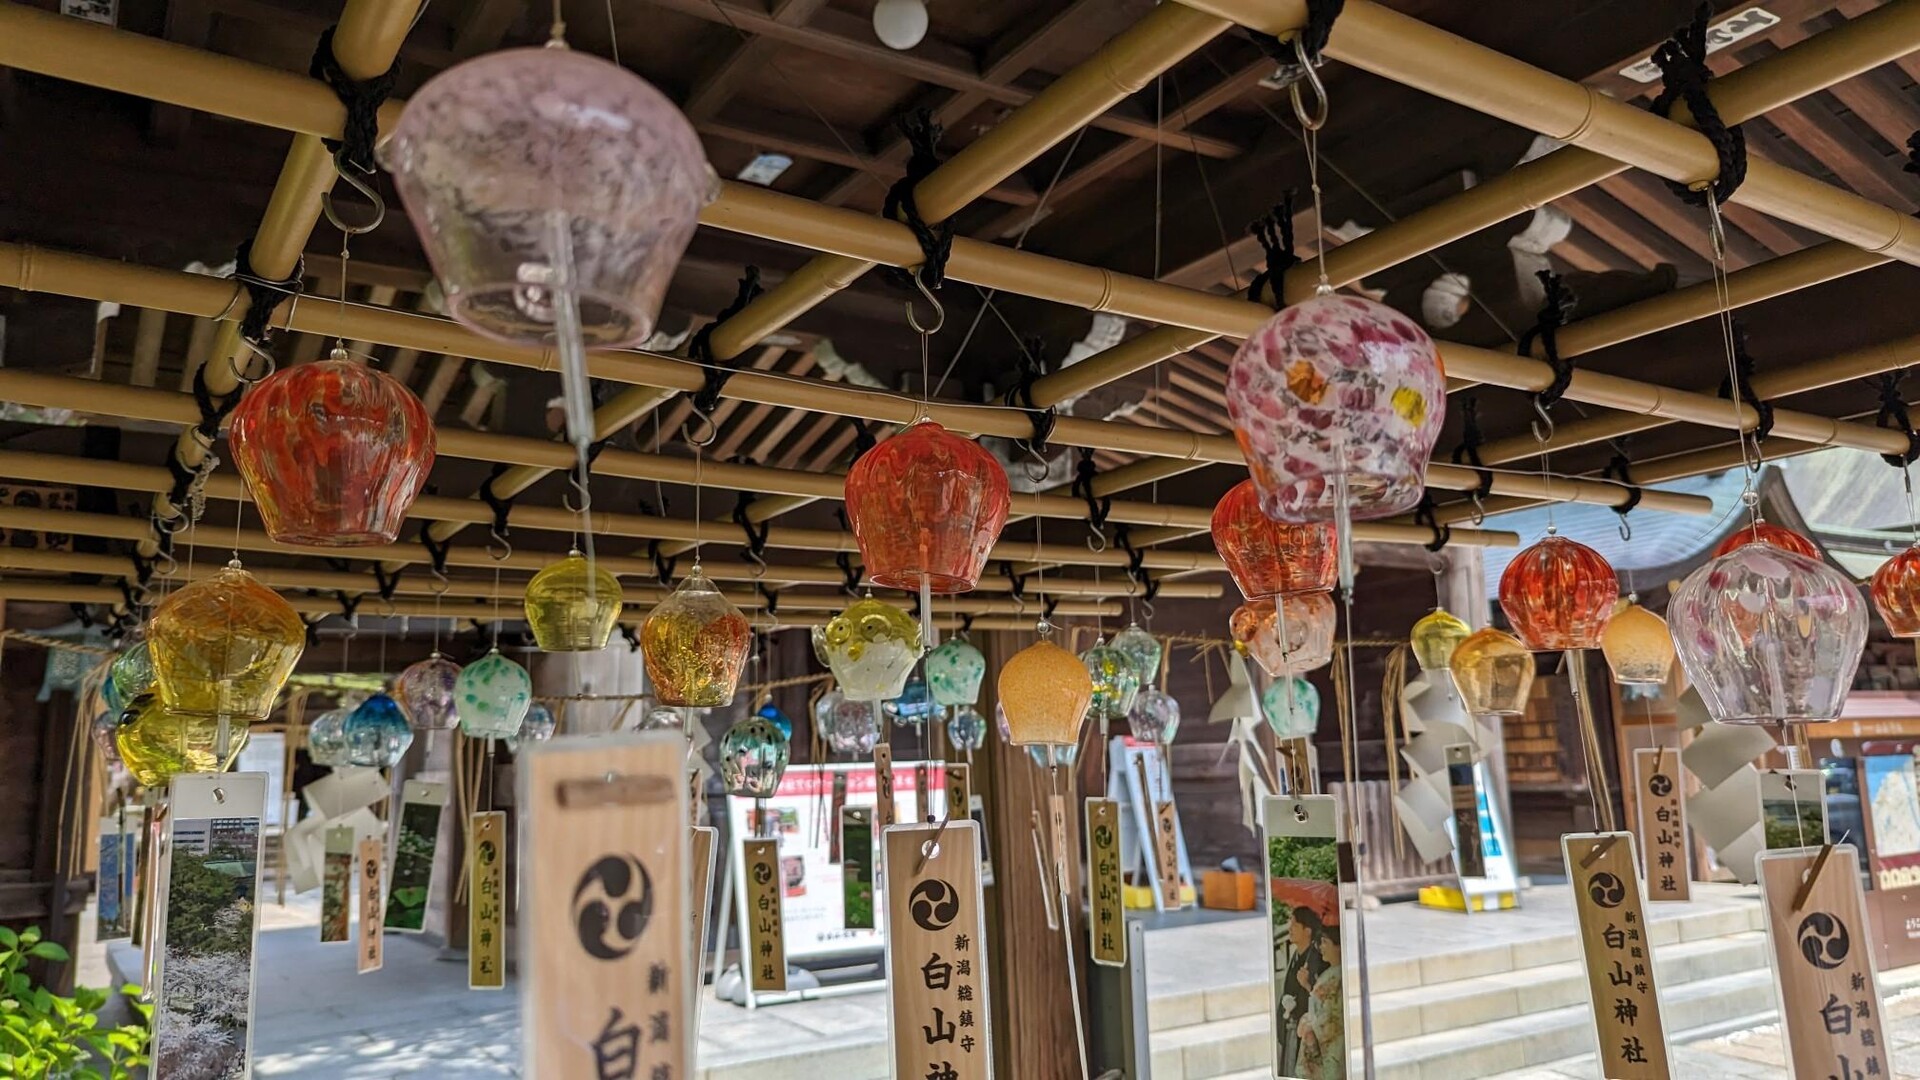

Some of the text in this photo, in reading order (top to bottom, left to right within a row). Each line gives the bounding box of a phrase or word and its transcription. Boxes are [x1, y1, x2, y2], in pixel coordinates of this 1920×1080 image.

[1654, 806, 1677, 891] 白山神社
[758, 895, 775, 980] 白山神社
[954, 934, 975, 1053] 新潟総鎮守
[1602, 923, 1648, 1063] 白山神社
